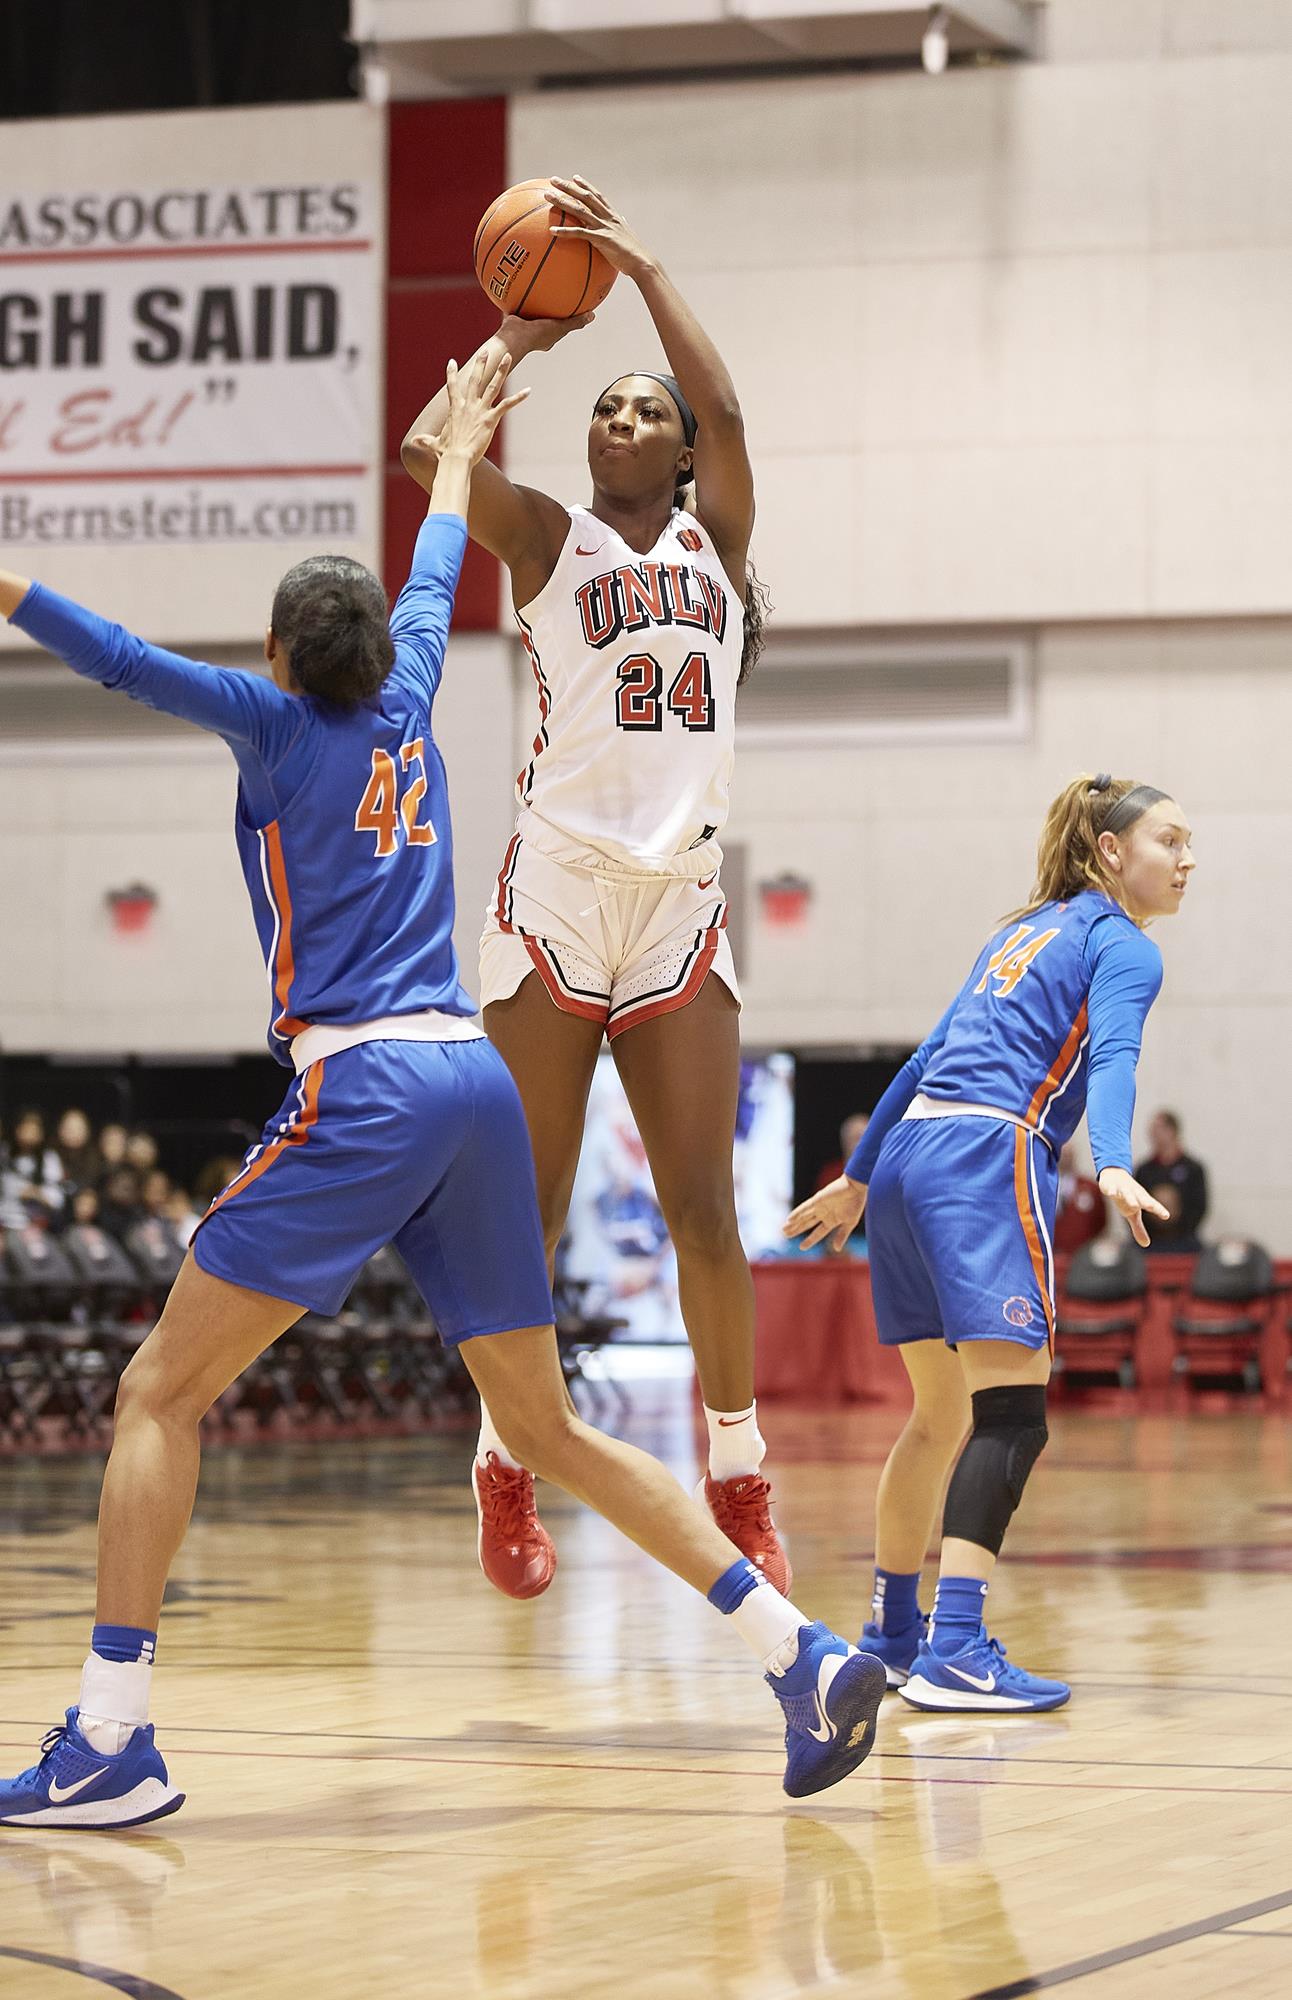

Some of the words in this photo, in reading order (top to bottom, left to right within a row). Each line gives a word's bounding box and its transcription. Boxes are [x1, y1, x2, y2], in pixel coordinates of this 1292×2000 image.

[0, 184, 359, 247] ASSOCIATES
[489, 239, 527, 300] ELITE
[0, 289, 103, 371] GH
[132, 282, 360, 374] SAID,
[1, 490, 357, 543] Bernstein.com
[575, 561, 728, 650] UNLV
[615, 651, 716, 733] 24
[354, 736, 438, 858] 42
[972, 922, 1062, 998] 14
